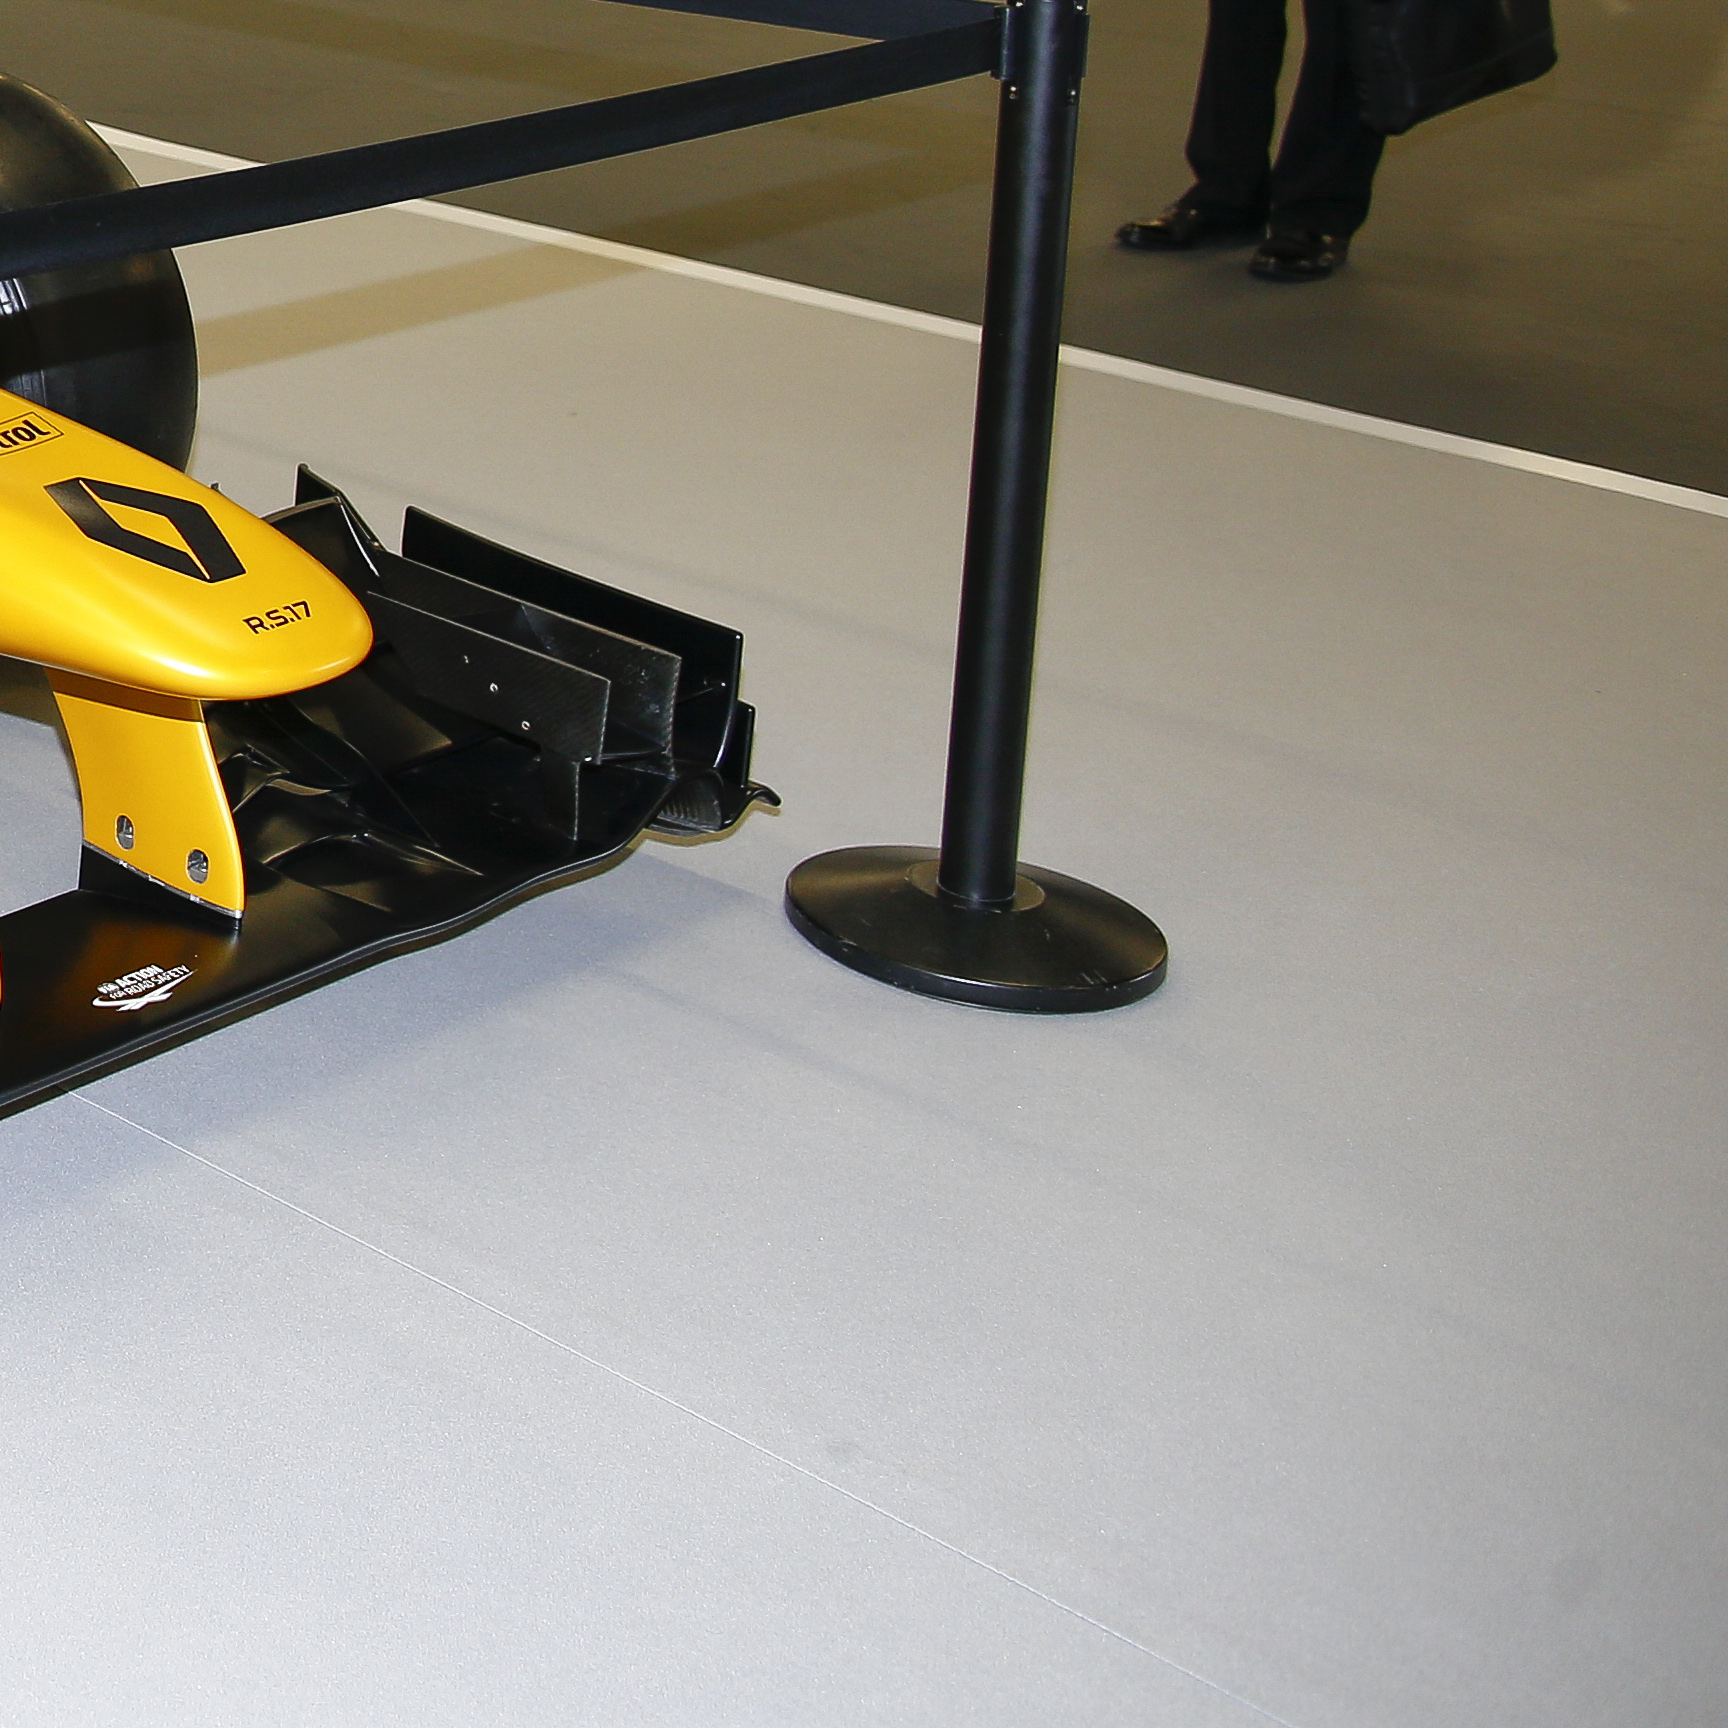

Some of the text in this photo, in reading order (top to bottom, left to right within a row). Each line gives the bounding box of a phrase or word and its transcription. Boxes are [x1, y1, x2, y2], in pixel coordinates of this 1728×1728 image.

[242, 600, 311, 635] R.S.17
[114, 964, 165, 988] ACTION
[124, 979, 155, 995] ROAD
[151, 964, 191, 985] SAFETY
